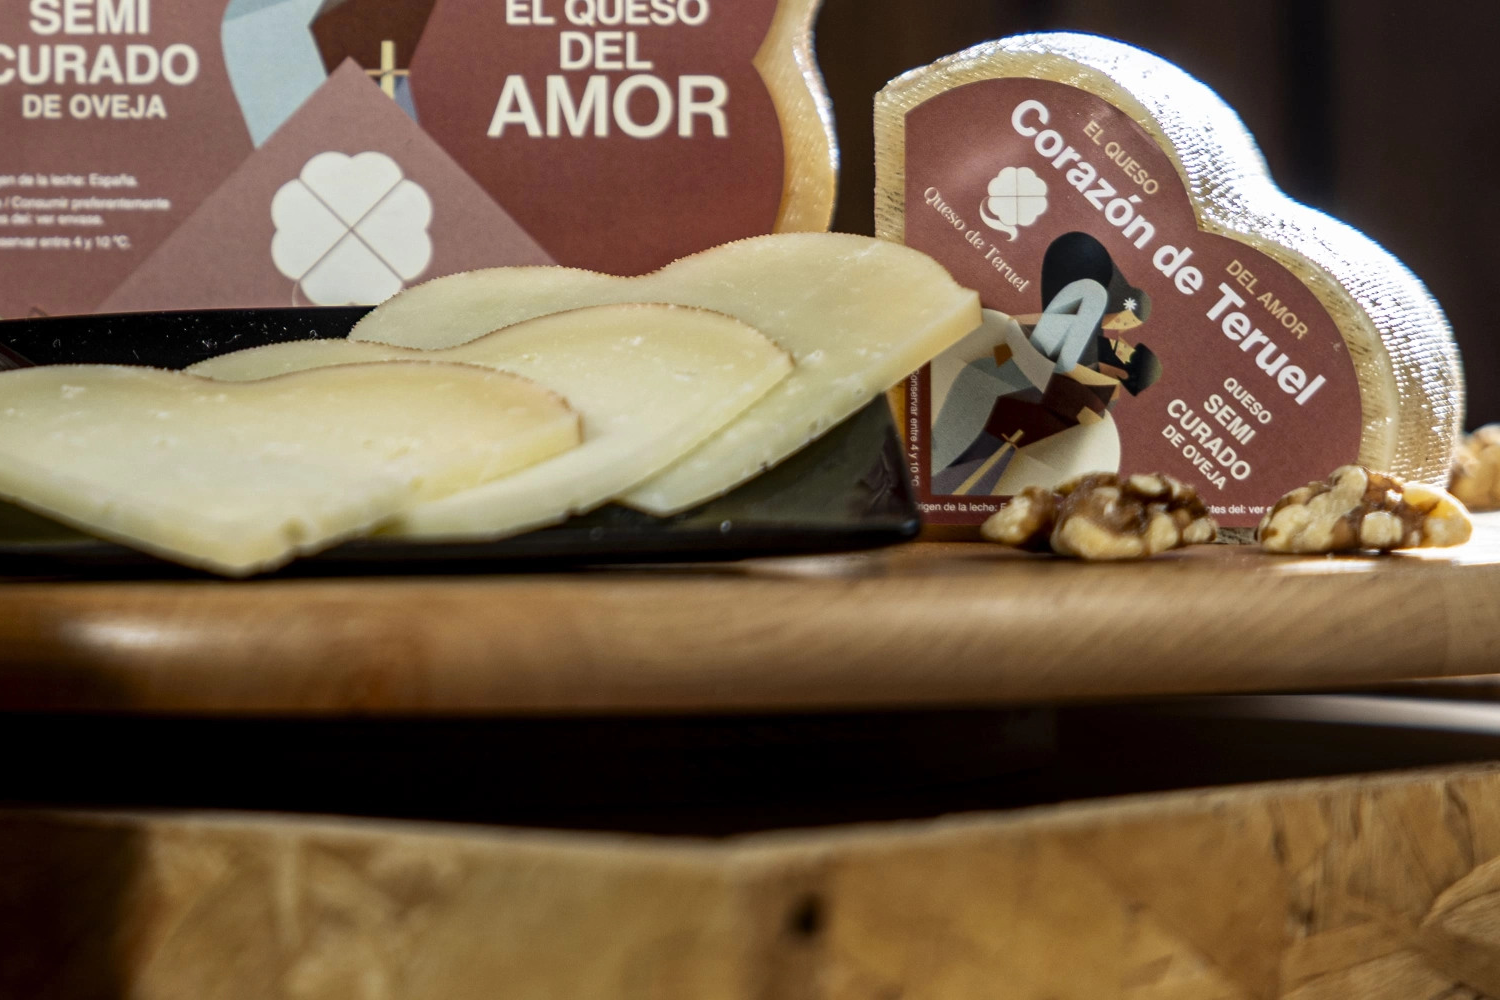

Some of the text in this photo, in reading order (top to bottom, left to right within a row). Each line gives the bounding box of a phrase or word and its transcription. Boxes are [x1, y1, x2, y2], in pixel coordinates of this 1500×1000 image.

[559, 31, 654, 70] DEL
[22, 94, 167, 119] DE OVEJA
[486, 74, 730, 139] AMOR
[1082, 120, 1159, 195] EL QUESO
[924, 186, 1030, 293] Queso de Teruel
[1011, 100, 1326, 405] Corazón de Teruel
[1225, 259, 1309, 340] DEL AMOR
[1203, 394, 1256, 445] SEMI
[1223, 377, 1272, 424] QUESO
[910, 418, 919, 442] entre
[1167, 399, 1251, 480] CURADO
[910, 461, 919, 473] 10
[1161, 424, 1226, 490] DE OVEJA
[915, 502, 941, 513] rigen
[943, 502, 956, 511] de
[958, 502, 967, 512] la
[969, 503, 998, 512] leche:
[1207, 504, 1226, 514] tes
[1228, 504, 1246, 514] del:
[1248, 506, 1264, 514] ver
